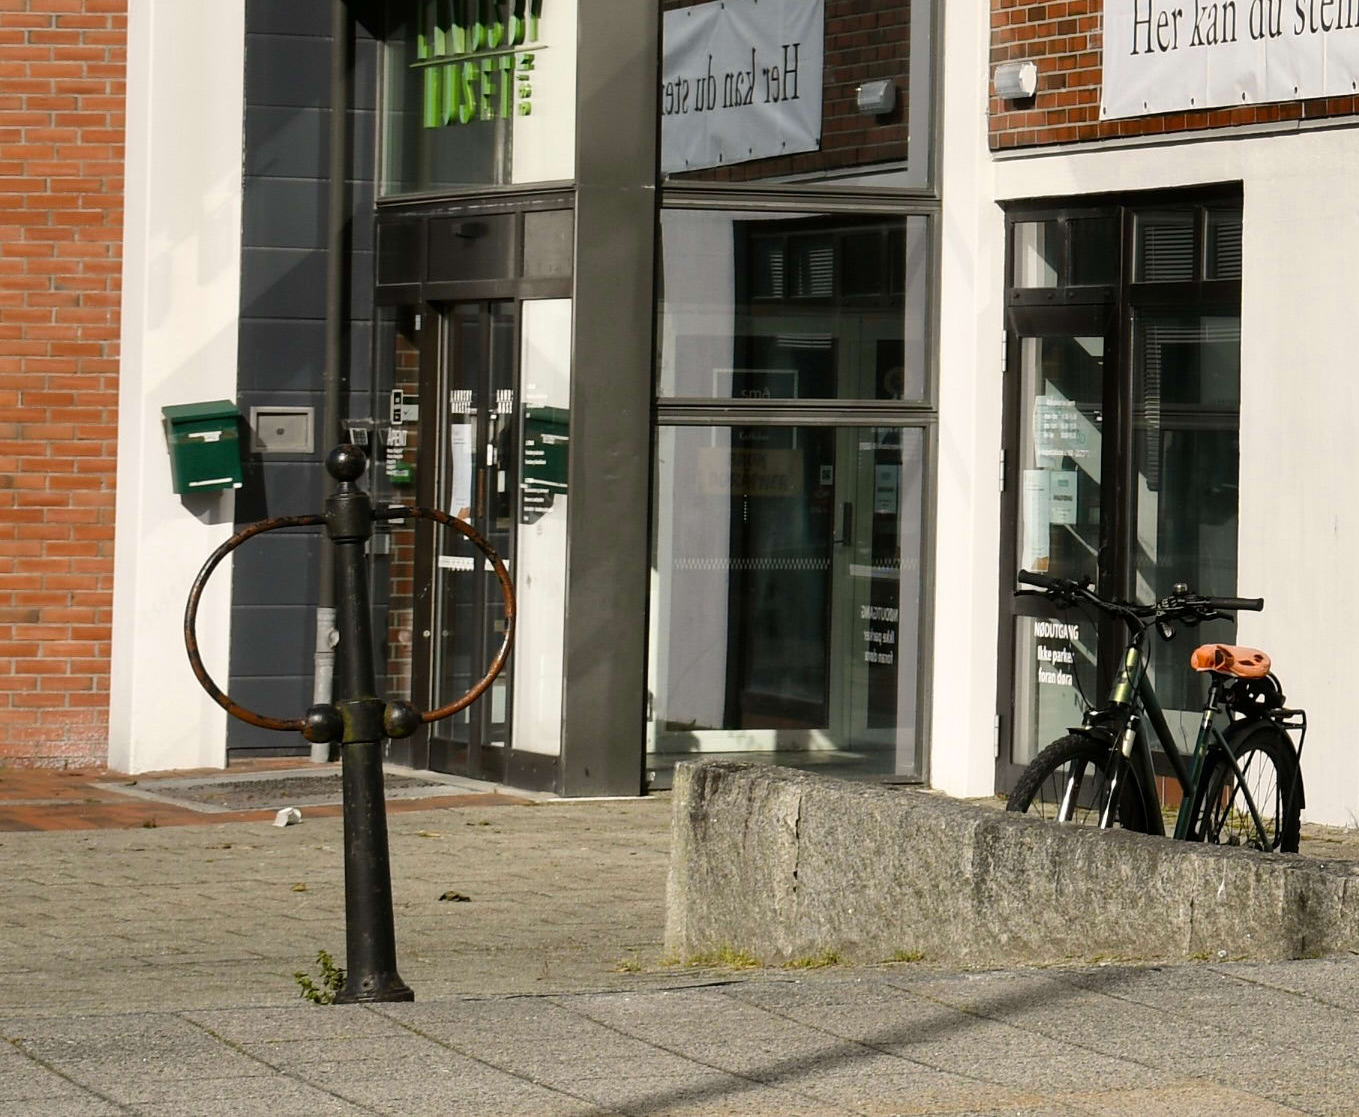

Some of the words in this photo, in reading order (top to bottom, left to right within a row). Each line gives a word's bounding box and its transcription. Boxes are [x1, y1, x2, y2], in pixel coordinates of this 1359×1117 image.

[1034, 621, 1079, 640] NØDUTGANG
[1037, 645, 1051, 661] Ikke
[1038, 667, 1056, 684] foran
